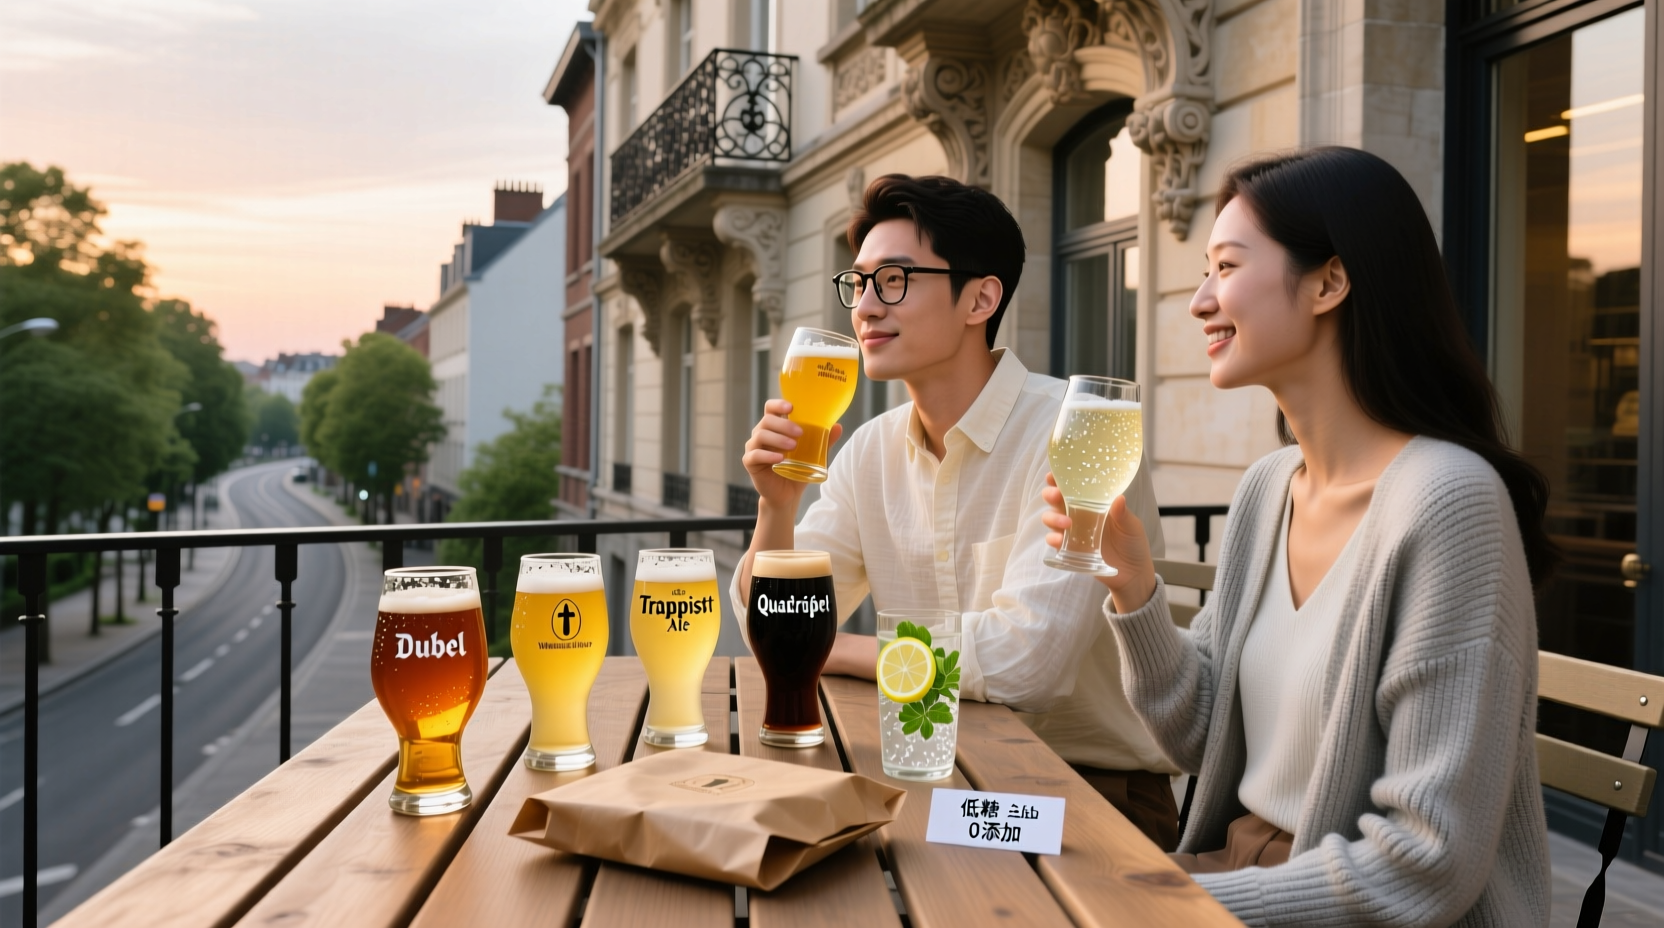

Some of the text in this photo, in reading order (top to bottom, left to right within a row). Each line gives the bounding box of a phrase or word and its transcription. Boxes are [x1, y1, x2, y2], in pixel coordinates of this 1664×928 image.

[666, 617, 691, 632] Ale
[394, 631, 467, 659] Dubel
[960, 797, 1000, 819] 低糖
[968, 820, 1021, 843] 0添加
